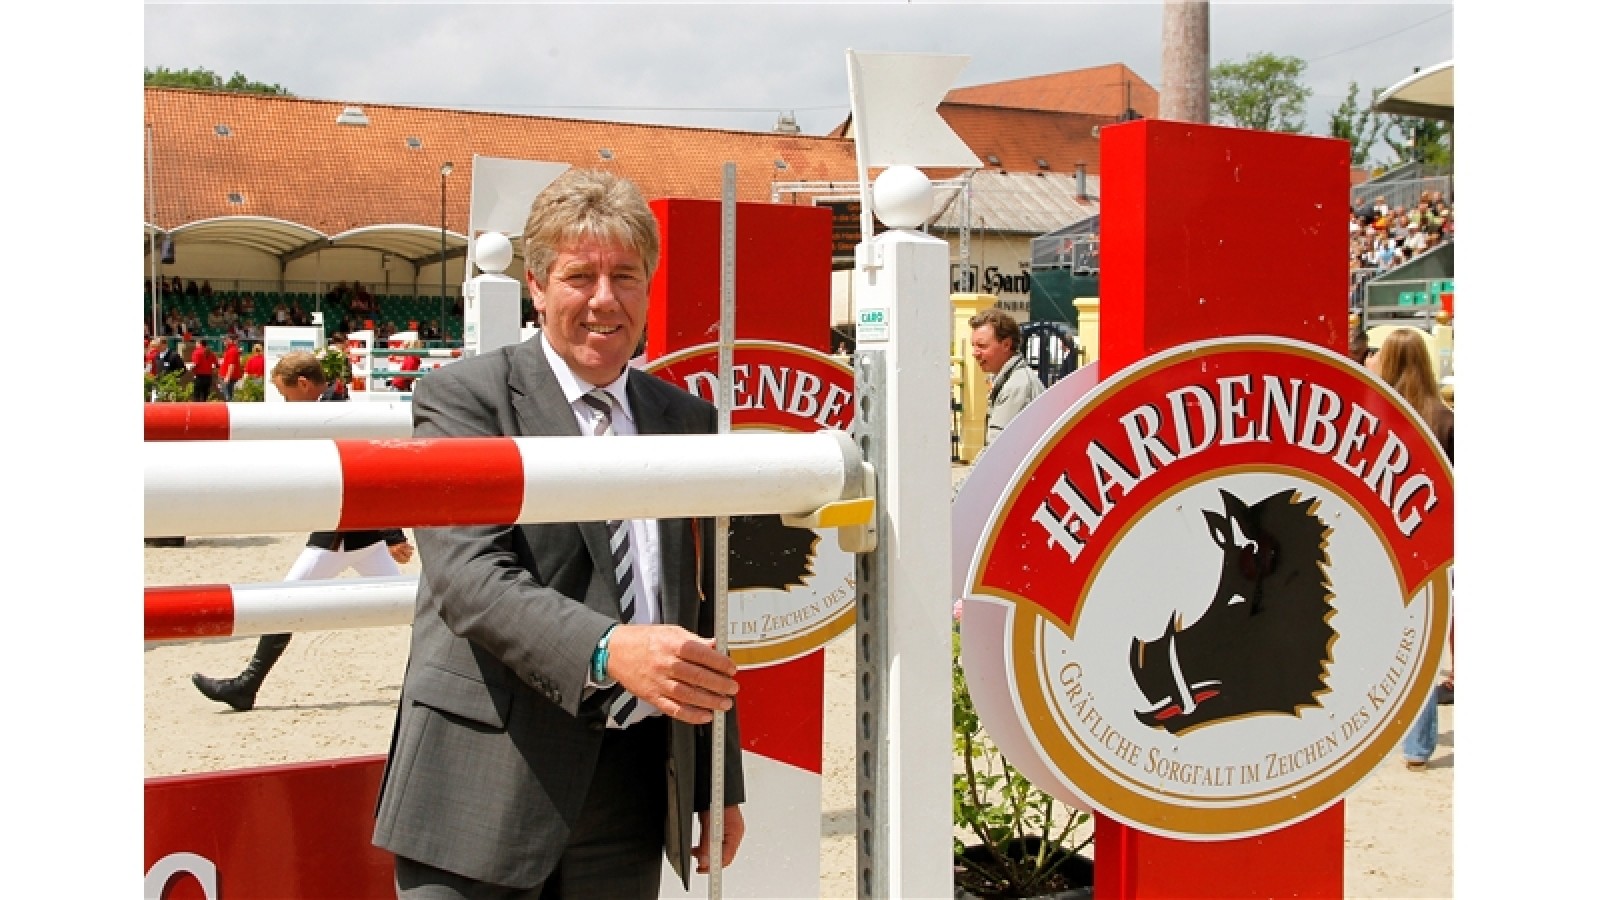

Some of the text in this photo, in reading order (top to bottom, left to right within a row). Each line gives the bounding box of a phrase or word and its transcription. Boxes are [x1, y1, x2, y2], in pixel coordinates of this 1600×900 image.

[1030, 374, 1439, 563] HARDENBERG
[1240, 763, 1260, 784] IM
[1340, 706, 1371, 740] DES
